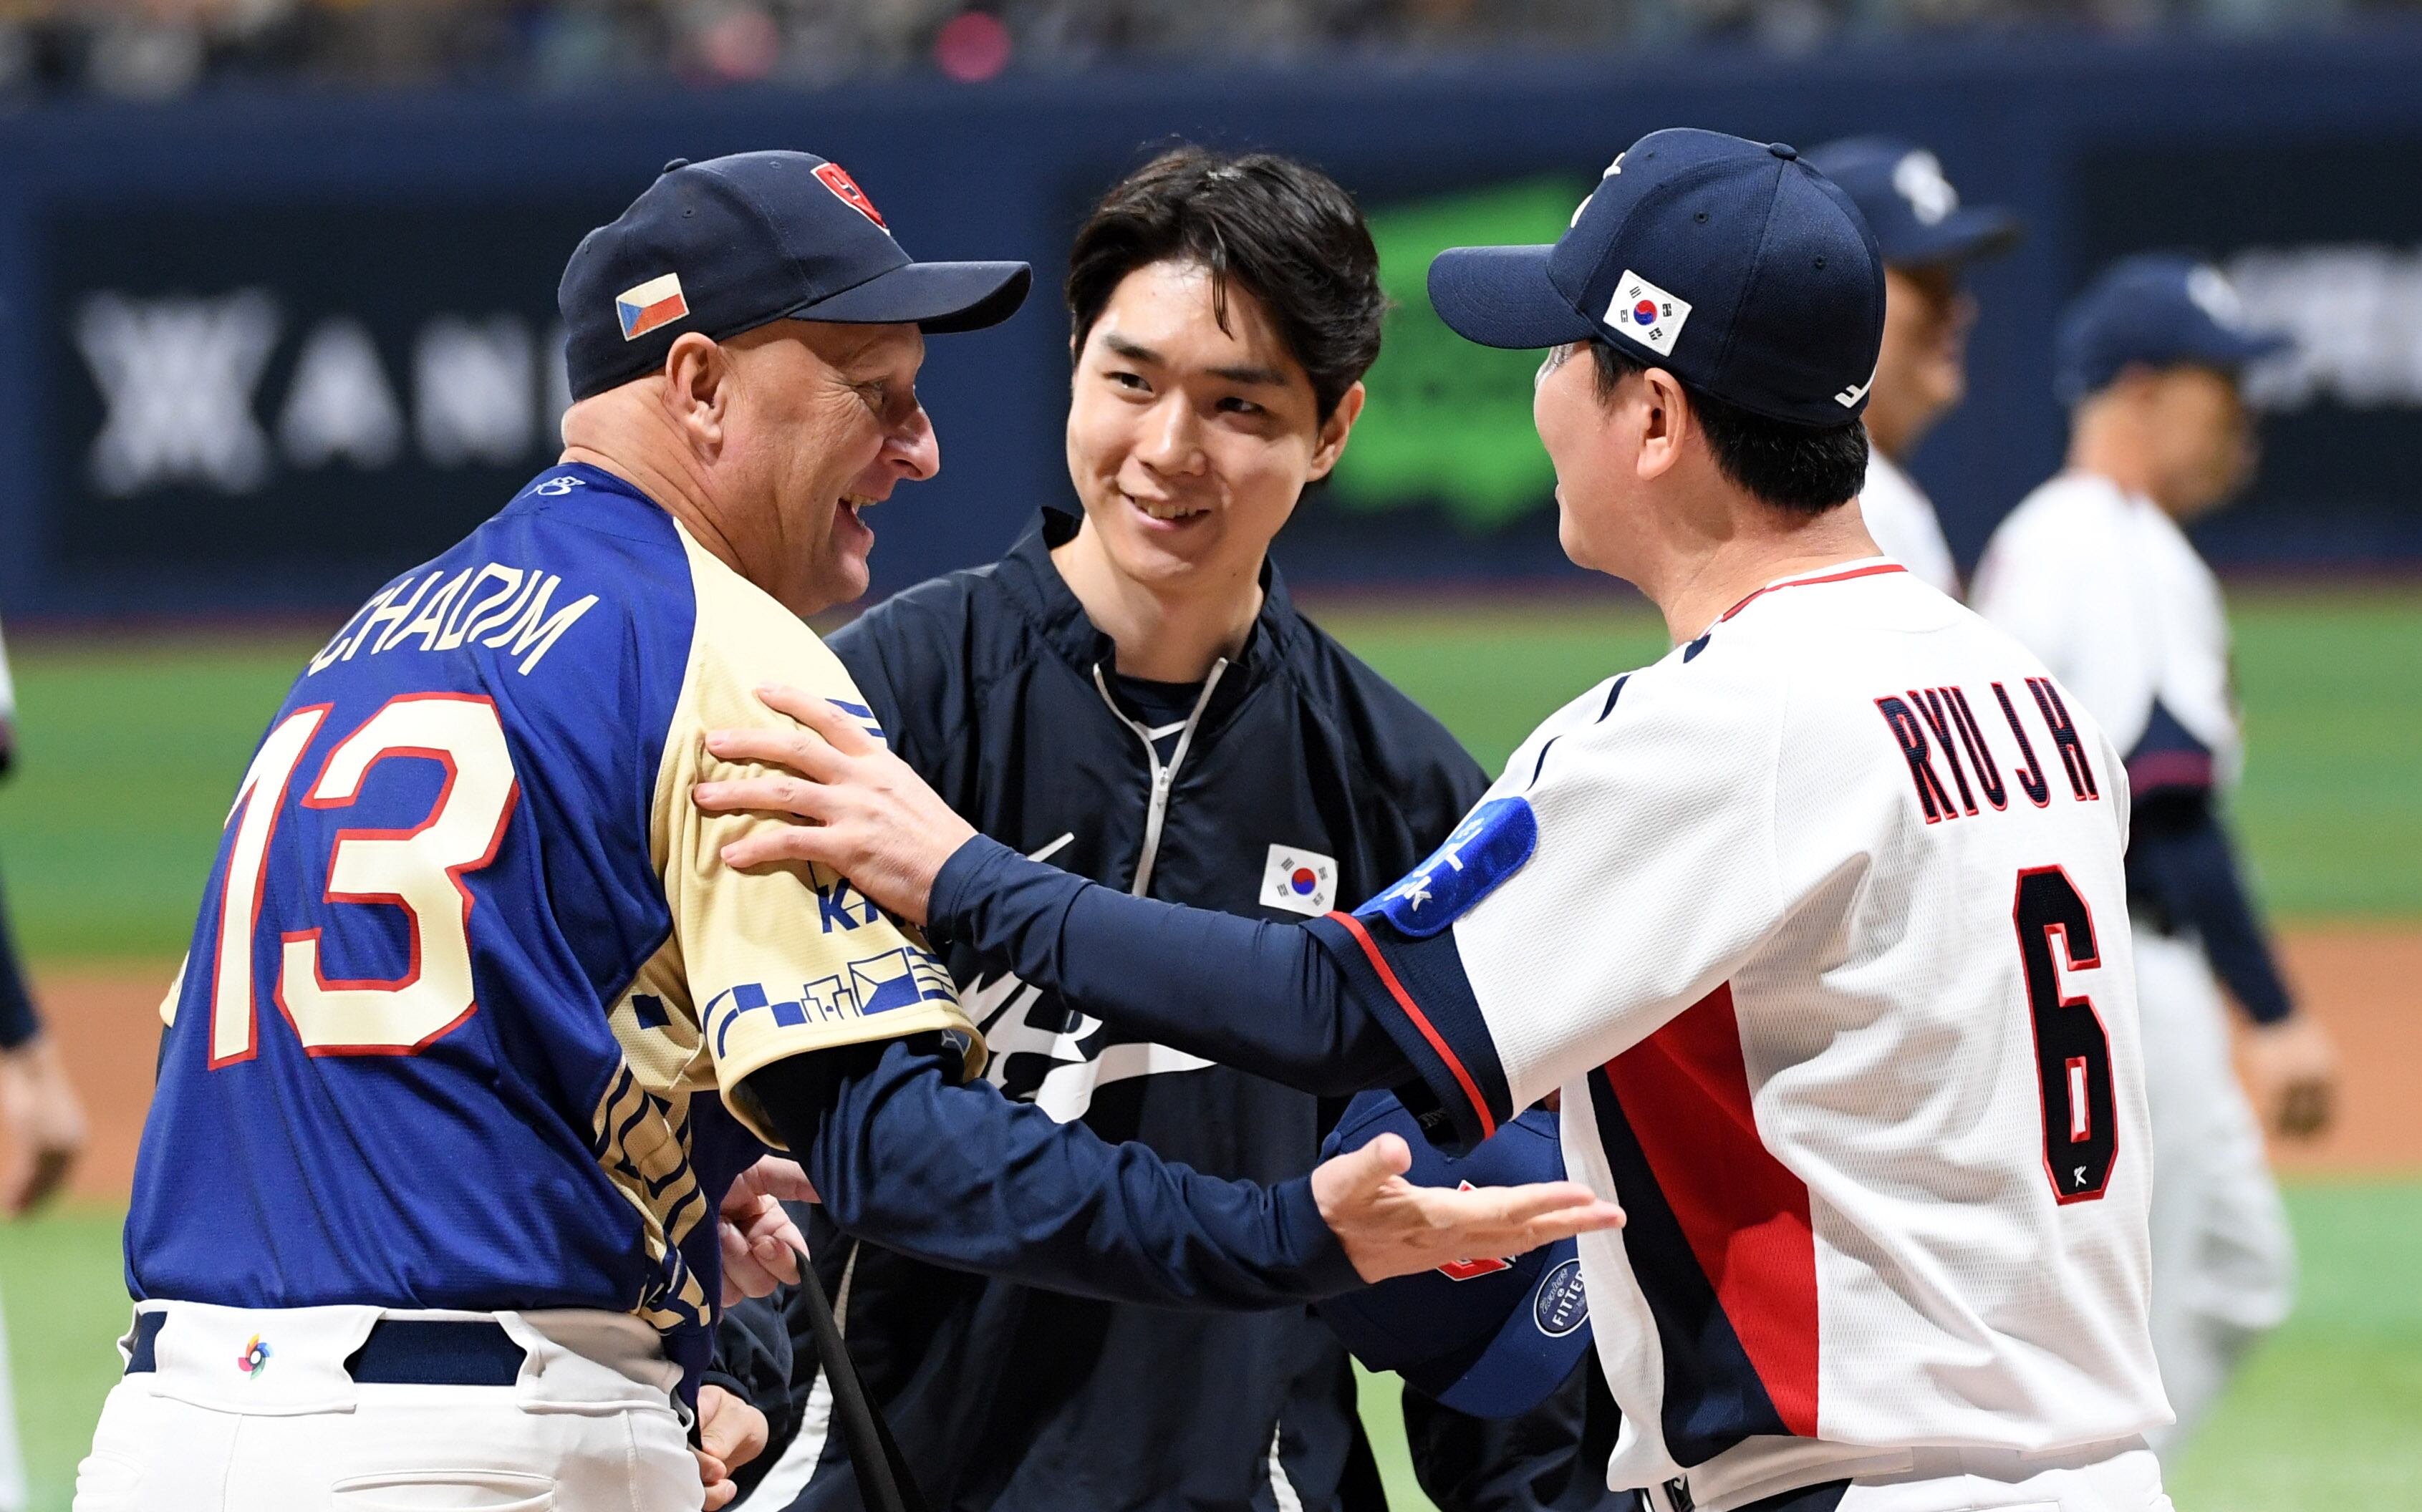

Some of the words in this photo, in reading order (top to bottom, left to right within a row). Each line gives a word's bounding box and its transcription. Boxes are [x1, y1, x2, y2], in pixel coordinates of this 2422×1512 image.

[208, 691, 520, 1070] 13
[1873, 686, 2007, 824] RYU
[1990, 682, 2050, 808] J
[2025, 677, 2099, 801] H
[2012, 863, 2118, 1206] 6
